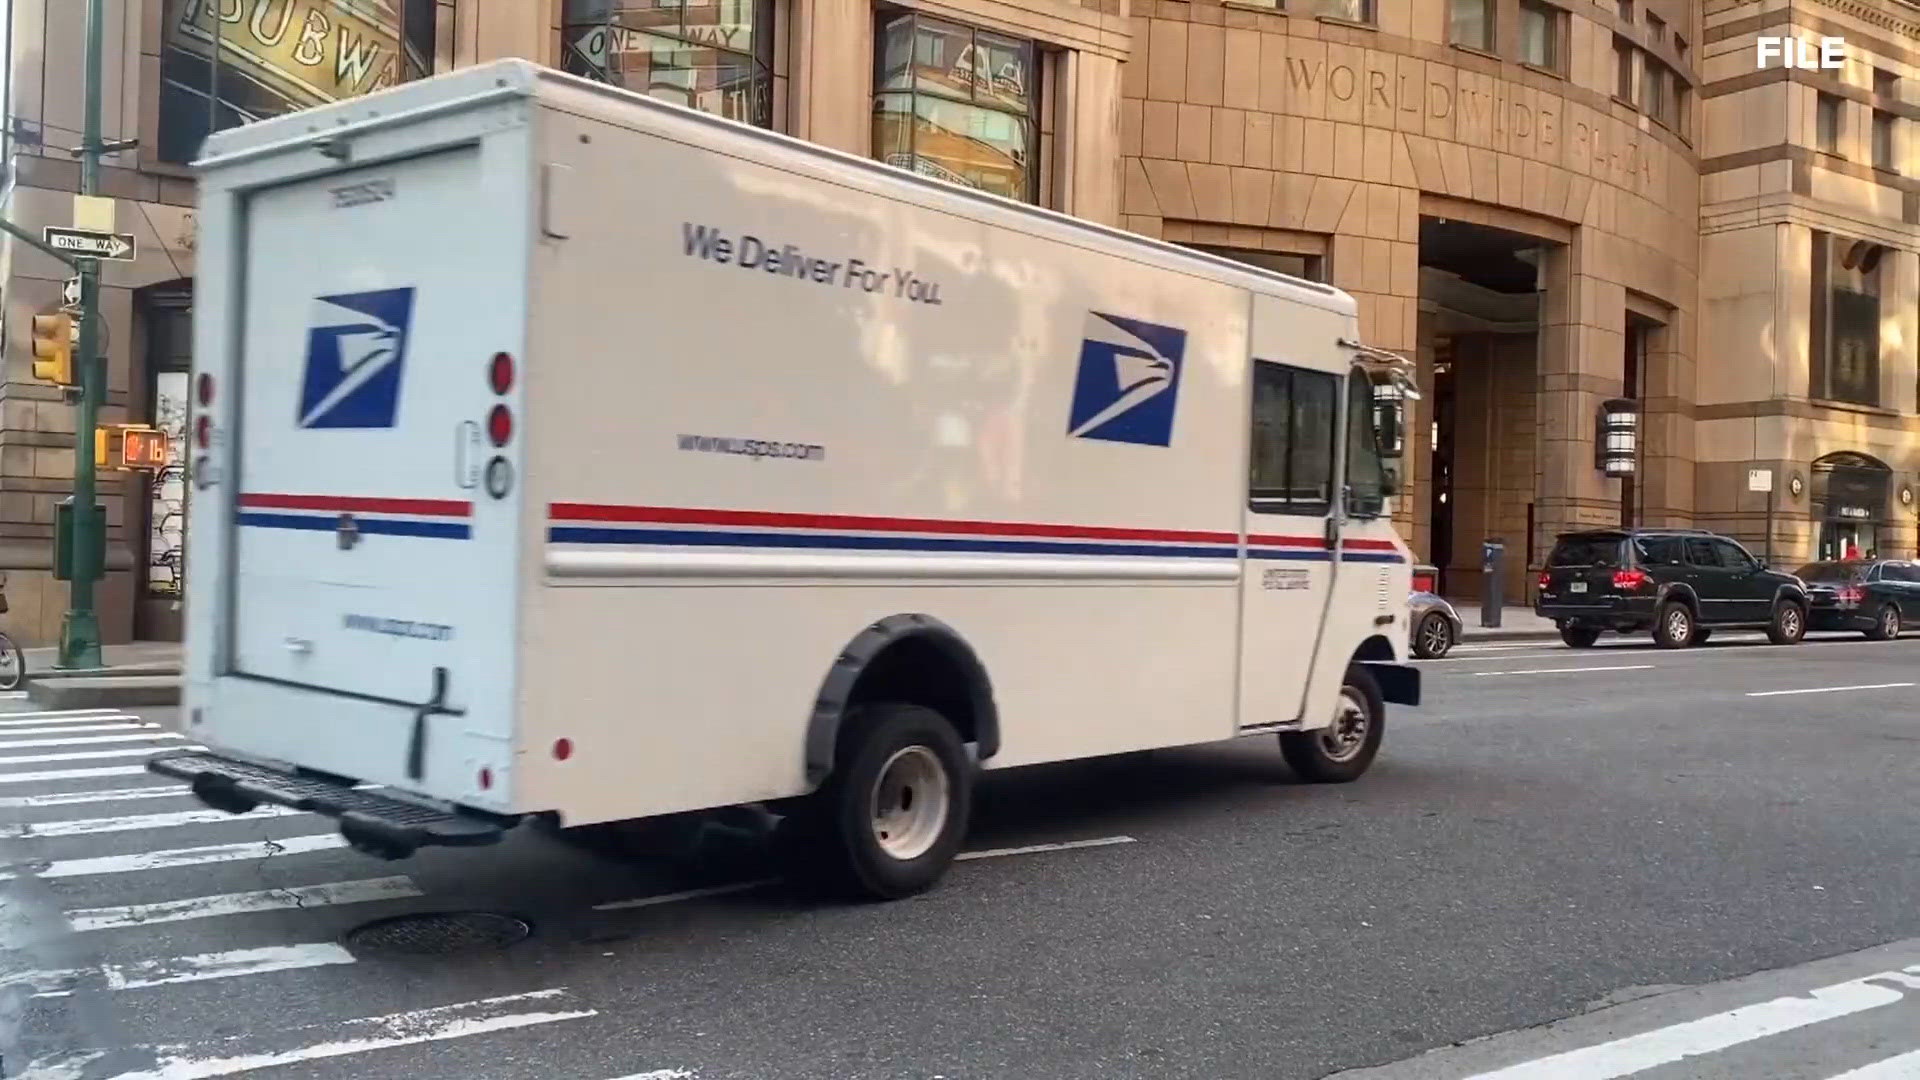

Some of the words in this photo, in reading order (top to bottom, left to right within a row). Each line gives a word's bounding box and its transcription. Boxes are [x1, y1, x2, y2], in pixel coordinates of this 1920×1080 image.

[590, 28, 638, 54] ONE
[678, 27, 738, 49] WAY
[1285, 57, 1553, 146] WORLDWIDE
[58, 236, 85, 248] ONE
[96, 239, 121, 250] WAY
[681, 222, 733, 264] We
[737, 236, 841, 286] Deliver
[843, 259, 889, 294] For
[676, 434, 825, 462] www.usps.com
